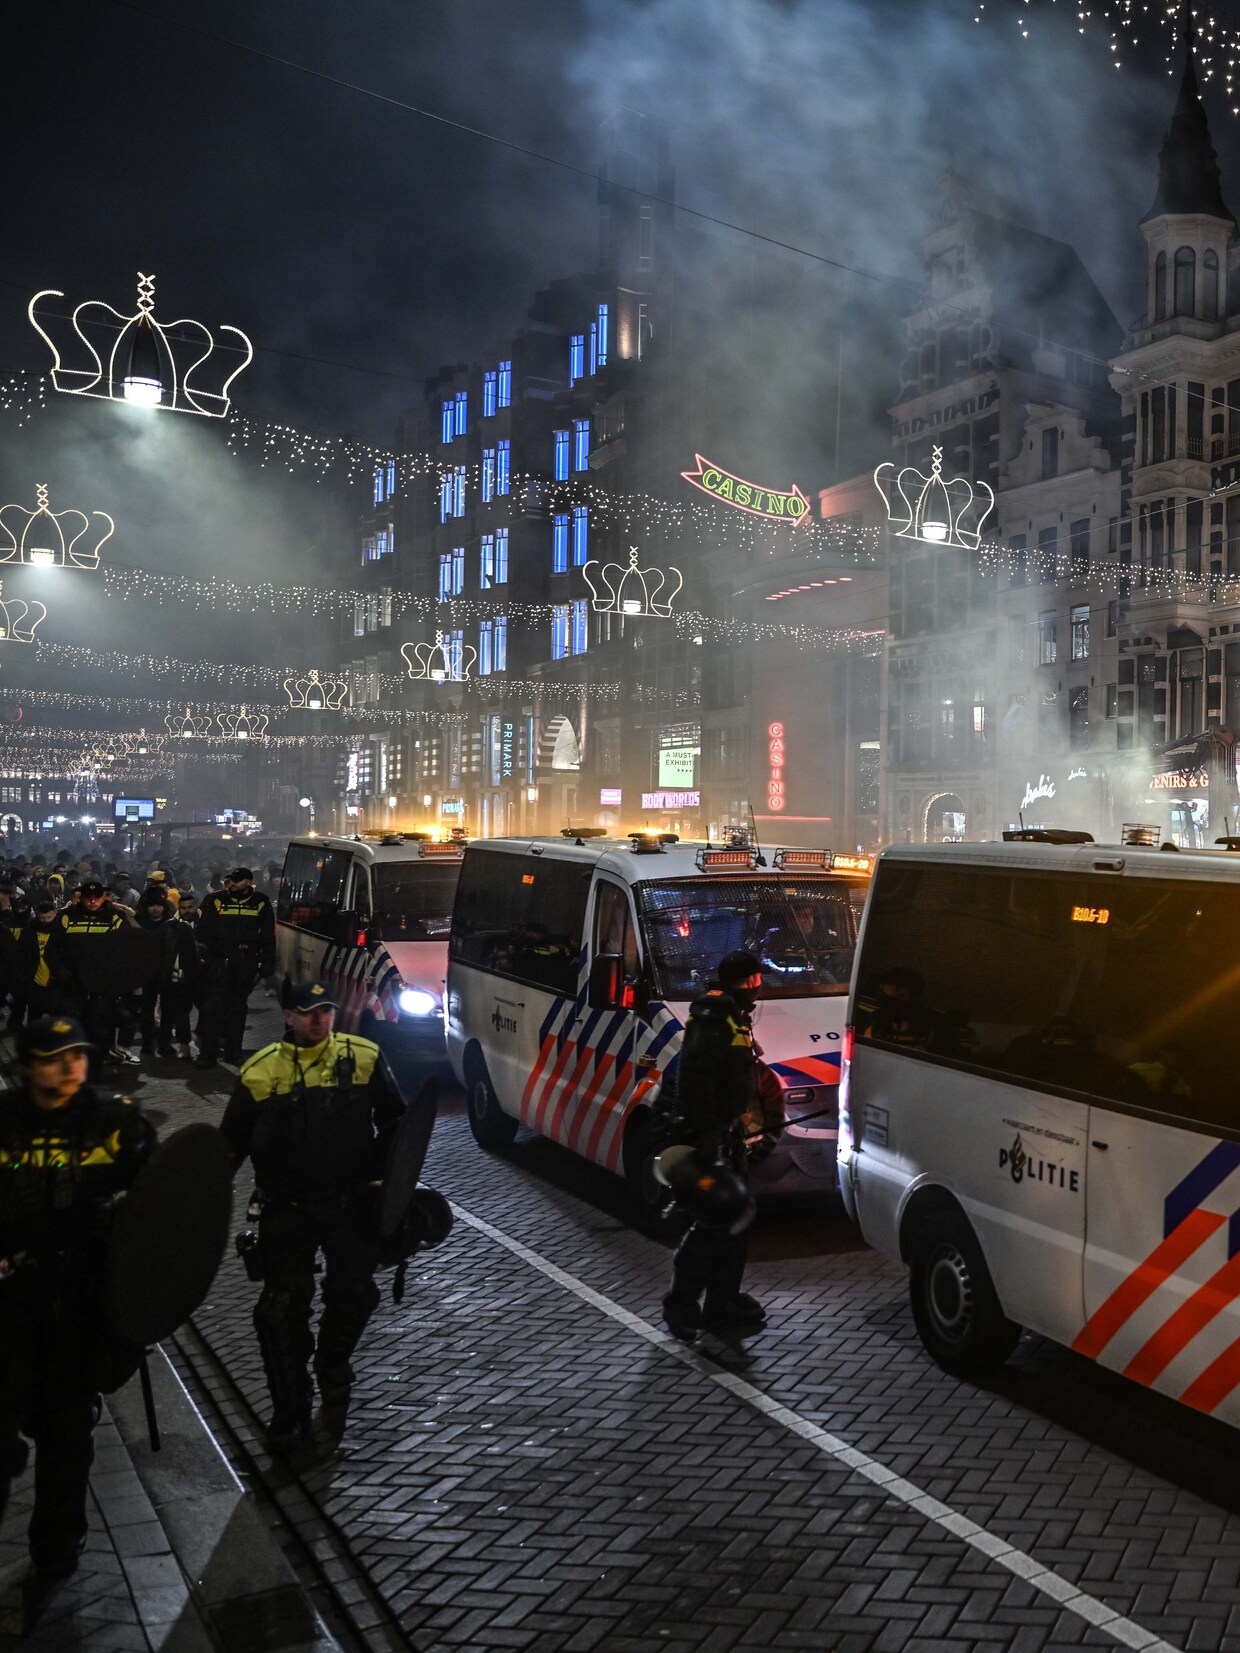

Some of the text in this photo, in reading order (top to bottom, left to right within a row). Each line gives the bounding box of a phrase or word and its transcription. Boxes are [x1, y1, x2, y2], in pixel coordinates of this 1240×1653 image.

[702, 469, 805, 517] CASINO
[503, 723, 513, 777] PRIMARK
[770, 724, 782, 808] CASINO
[641, 793, 664, 809] BODY
[664, 791, 700, 808] WORLDS
[491, 1012, 517, 1033] POLITIE
[999, 1147, 1079, 1192] POLITIE
